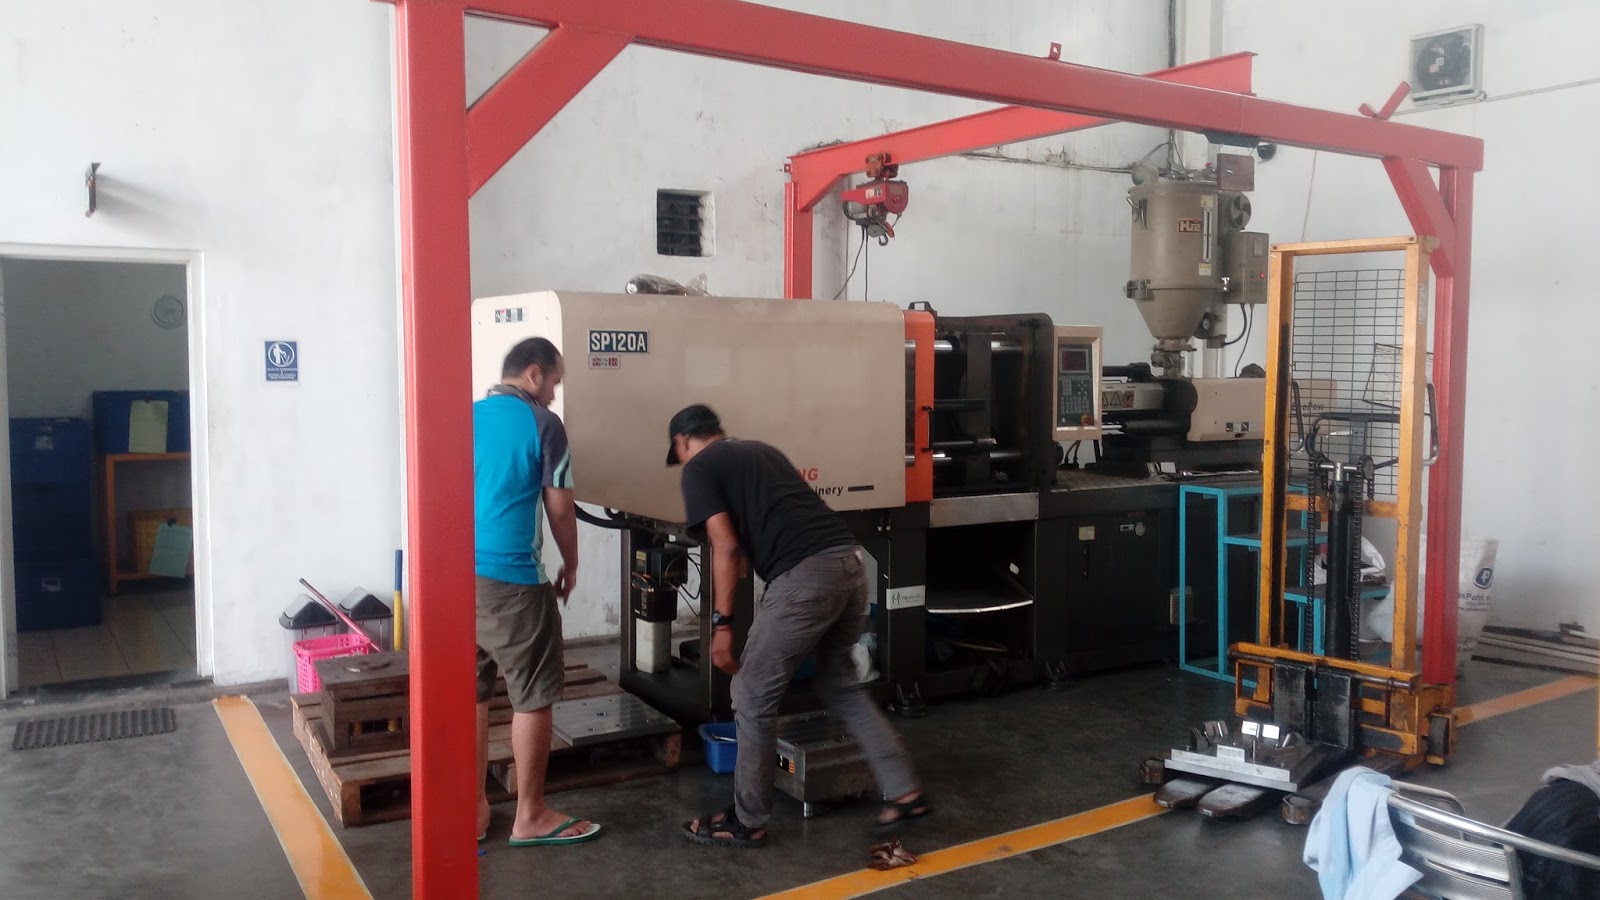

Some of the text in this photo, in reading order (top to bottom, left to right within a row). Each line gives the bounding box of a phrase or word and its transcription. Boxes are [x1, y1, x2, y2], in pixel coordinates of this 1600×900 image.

[591, 331, 646, 352] SP120A
[797, 467, 818, 481] NG
[814, 485, 844, 497] inery
